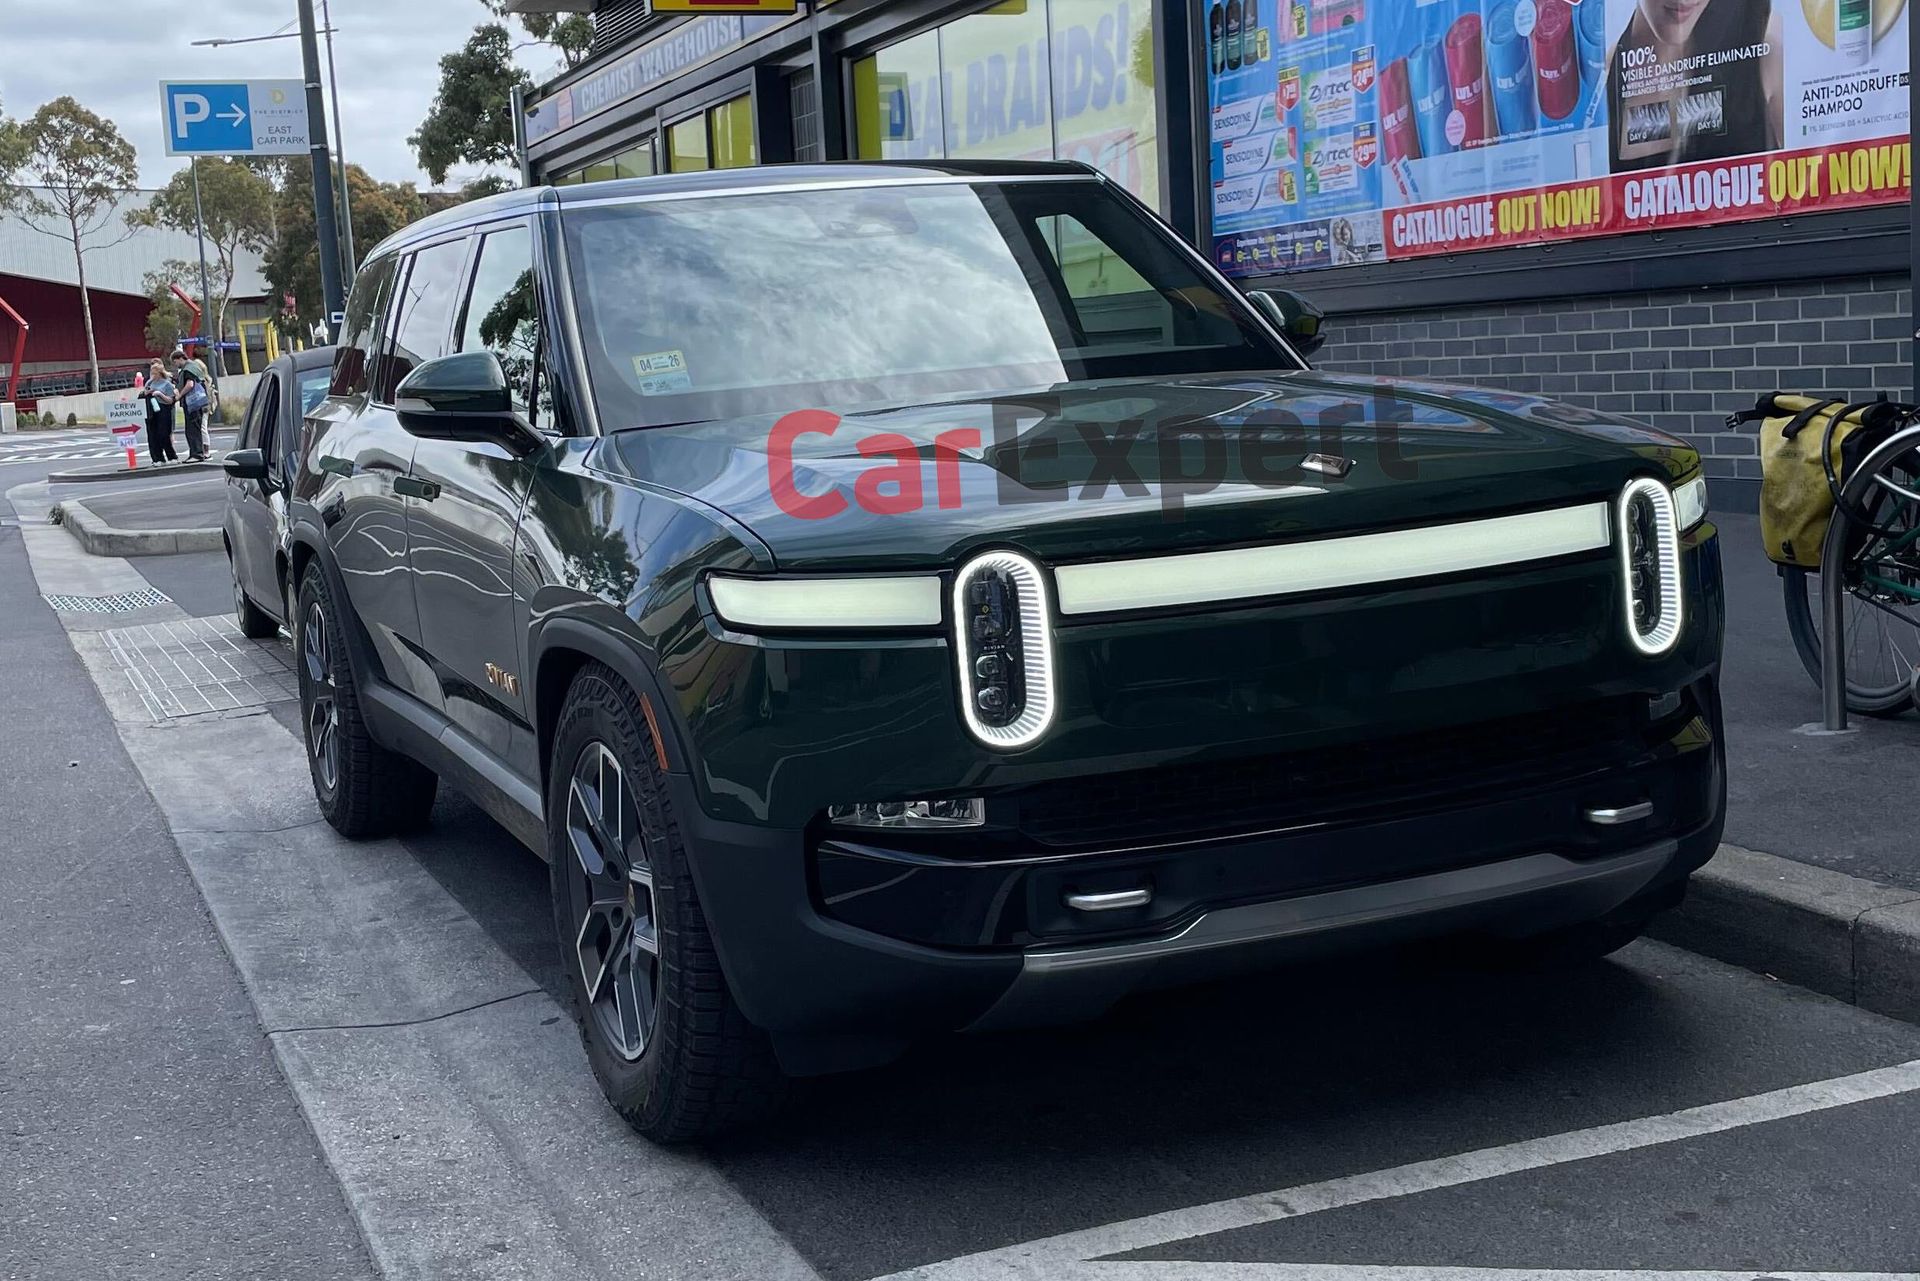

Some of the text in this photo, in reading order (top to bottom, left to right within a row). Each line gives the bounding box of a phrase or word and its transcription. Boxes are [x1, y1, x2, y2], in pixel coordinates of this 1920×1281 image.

[581, 15, 740, 113] CHEMIST WAREHOUSE
[1621, 45, 1657, 69] 100%
[1622, 42, 1770, 83] VISIBLE DANDRUFF ELIMINATED
[967, 1, 1130, 146] BRANDS!
[1309, 80, 1352, 103] Zyrtec
[1622, 86, 1657, 98] REBALANCED
[1675, 74, 1712, 88] MICROBIOME
[1802, 74, 1898, 103] ANTI-DANDRUFF
[173, 93, 211, 138] P
[1802, 97, 1863, 119] SHAMPOO
[268, 126, 292, 135] EAST
[1214, 111, 1252, 130] SENSODYNE
[1698, 121, 1712, 131] DAY
[256, 136, 305, 145] CAR PARK
[1629, 132, 1642, 141] DAY
[1226, 147, 1264, 165] SENSODYNE
[1312, 147, 1353, 167] Zyrtec
[1624, 142, 1911, 220] CATALOGUE OUT NOW!
[1217, 187, 1254, 204] SENSODYNE
[1393, 201, 1494, 248] CATALOGUE
[1499, 195, 1537, 235] OUT
[1541, 186, 1600, 230] NOW!
[640, 354, 680, 371] 04 26
[110, 410, 142, 419] PARKING
[114, 403, 136, 412] CREW
